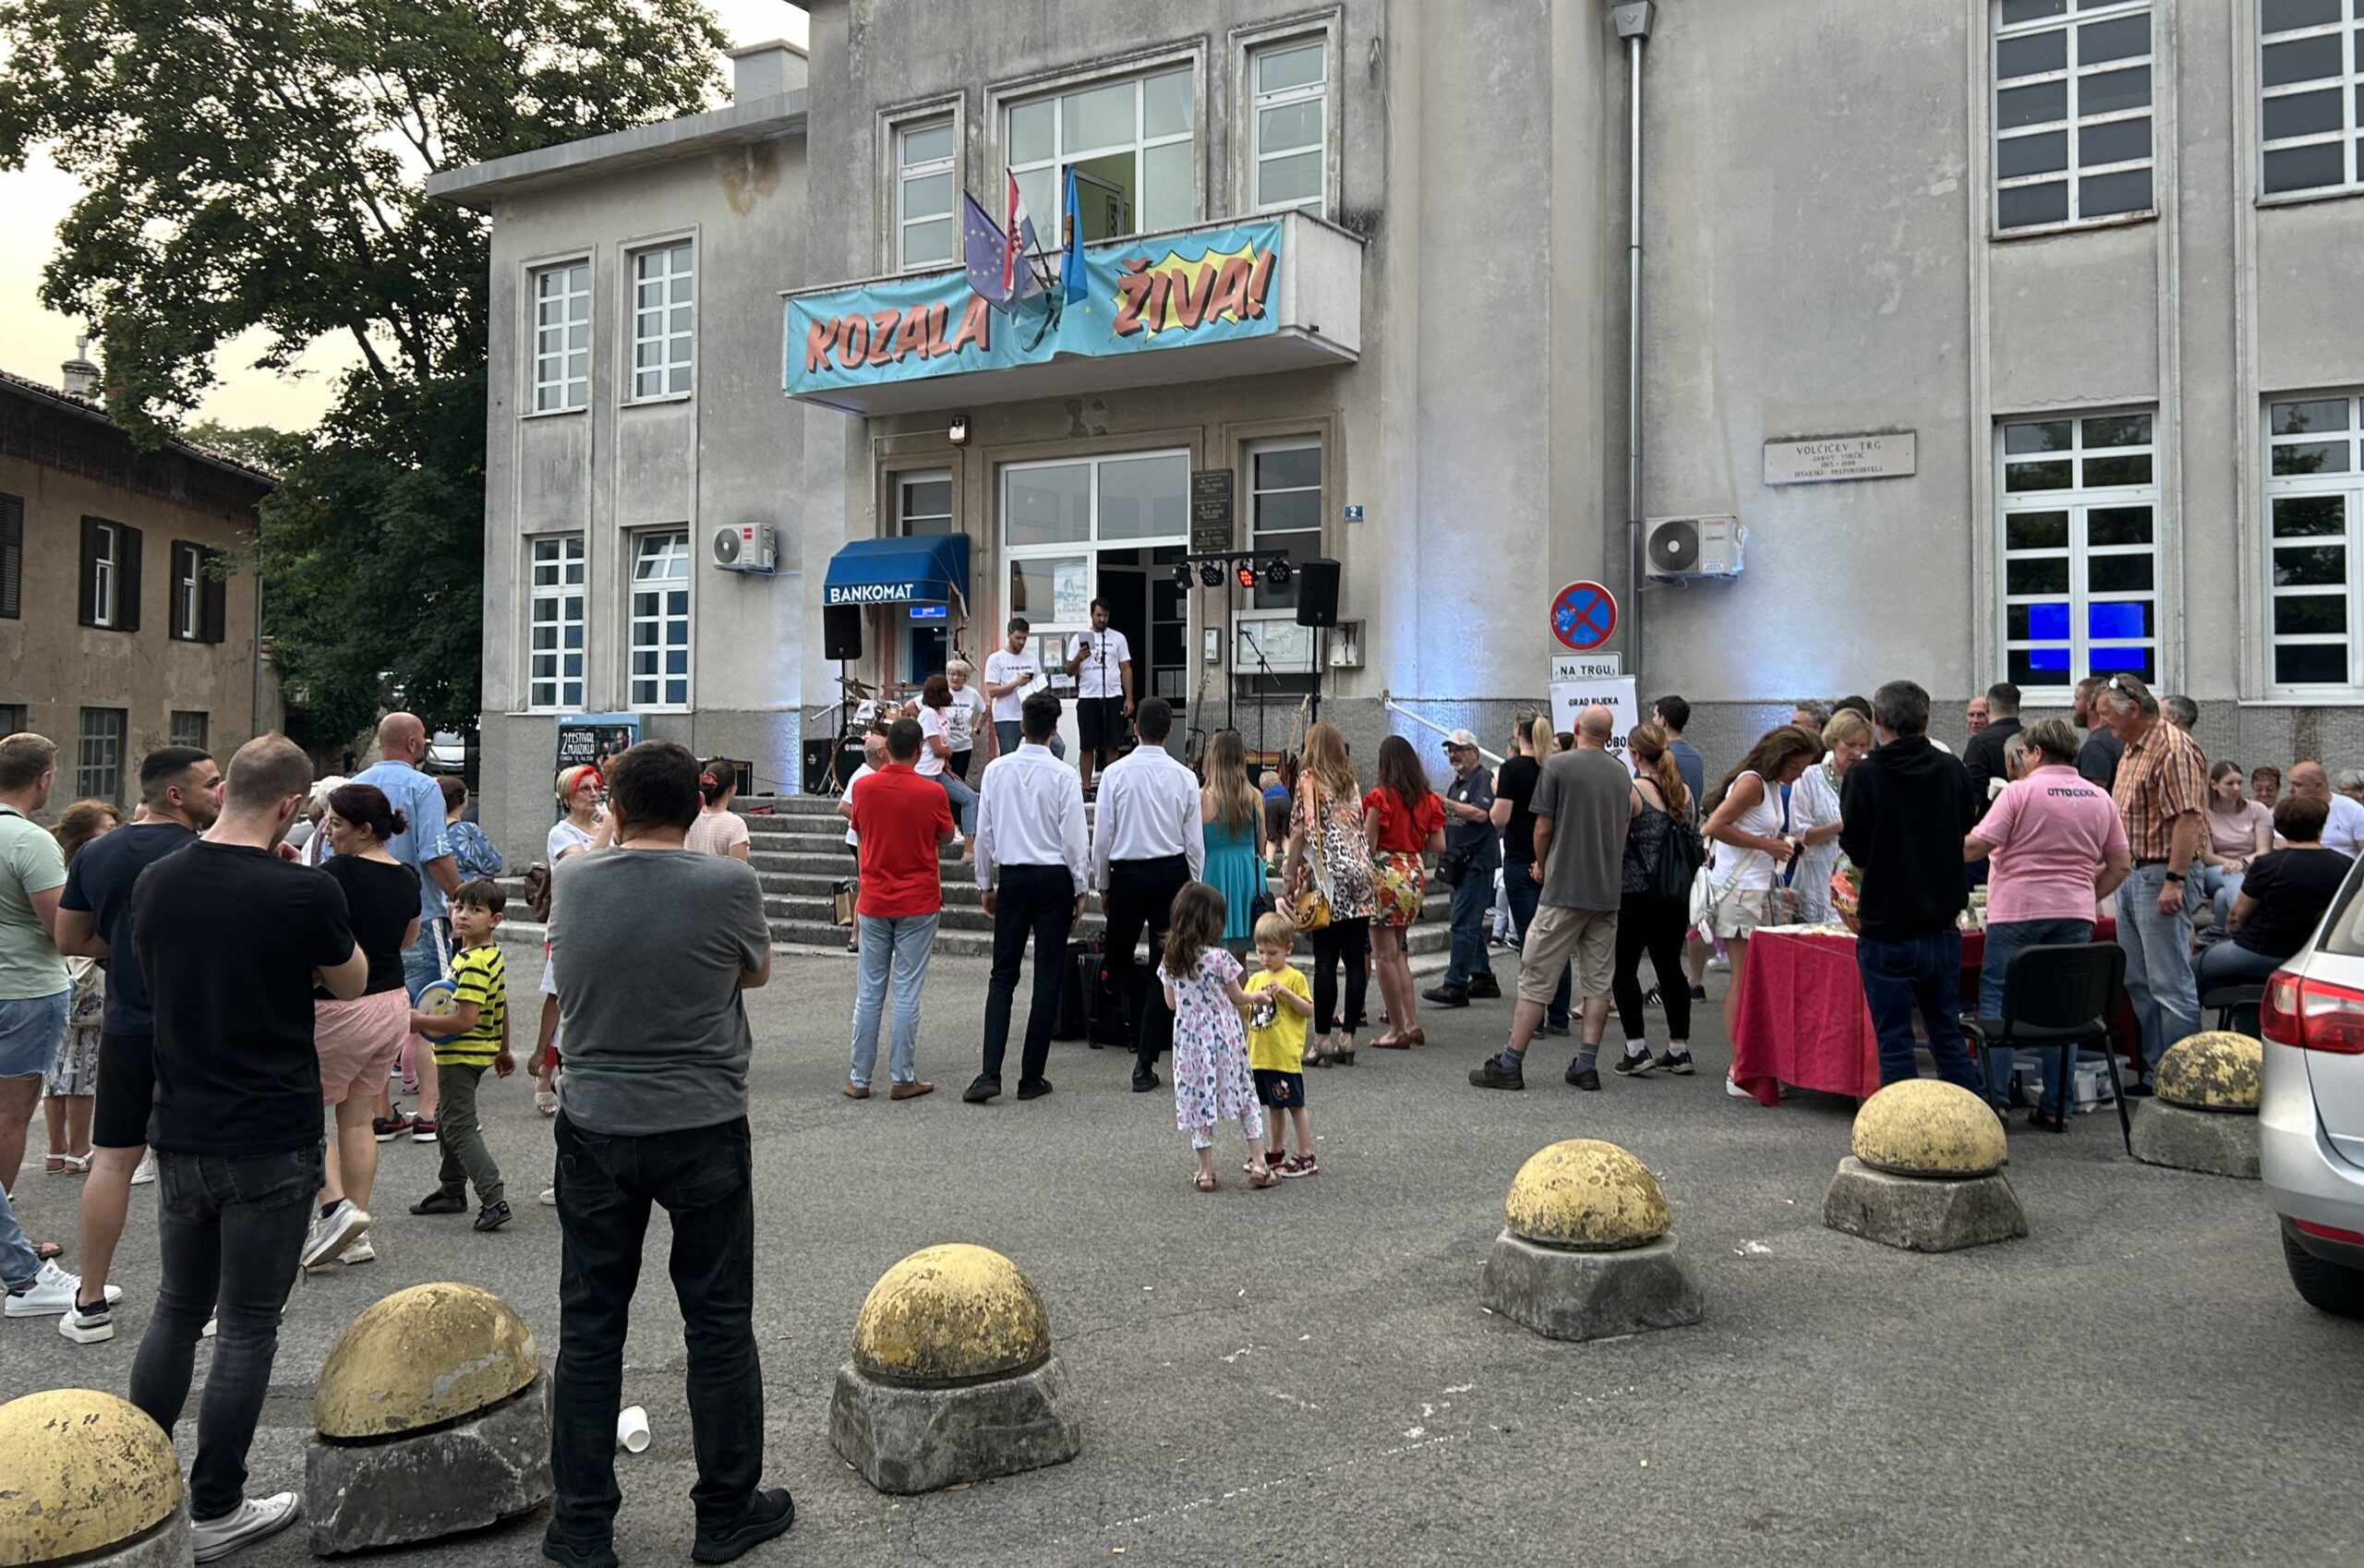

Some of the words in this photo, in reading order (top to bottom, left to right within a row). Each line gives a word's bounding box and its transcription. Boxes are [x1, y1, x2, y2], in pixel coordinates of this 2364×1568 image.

[805, 293, 991, 374] KOZALA
[1113, 248, 1277, 338] ŽIVA!
[1859, 440, 1881, 452] TRG
[1349, 505, 1357, 517] 2
[830, 583, 914, 603] BANKOMAT
[1560, 665, 1575, 675] NA
[1580, 665, 1610, 675] TRGU
[1568, 696, 1589, 707] GRAD
[1590, 695, 1619, 706] RIJEKA
[561, 732, 568, 754] 2
[568, 731, 595, 743] FESTIVAL
